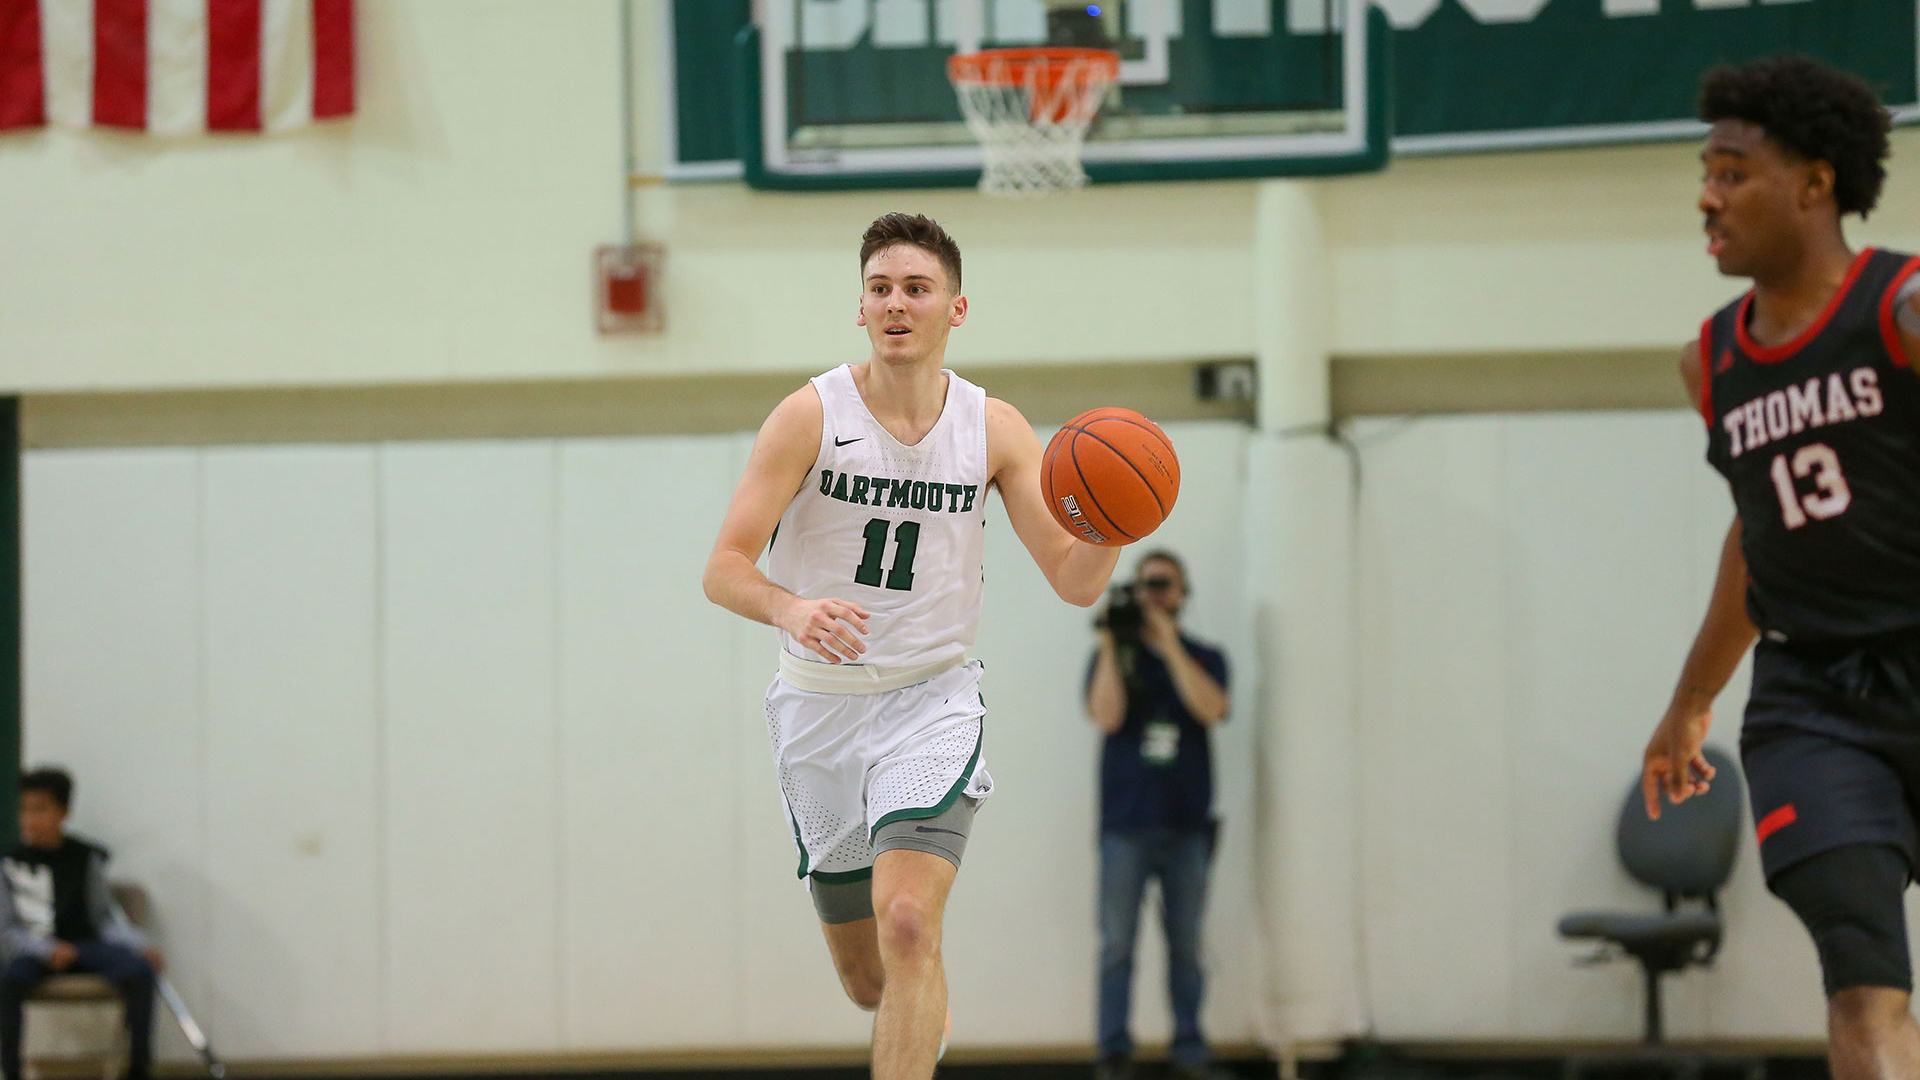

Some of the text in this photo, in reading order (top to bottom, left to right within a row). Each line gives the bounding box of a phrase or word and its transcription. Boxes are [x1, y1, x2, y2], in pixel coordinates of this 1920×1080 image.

[1723, 366, 1884, 458] THOMAS
[819, 469, 978, 513] DARTMOUTH
[1770, 442, 1852, 530] 13
[854, 517, 921, 591] 11
